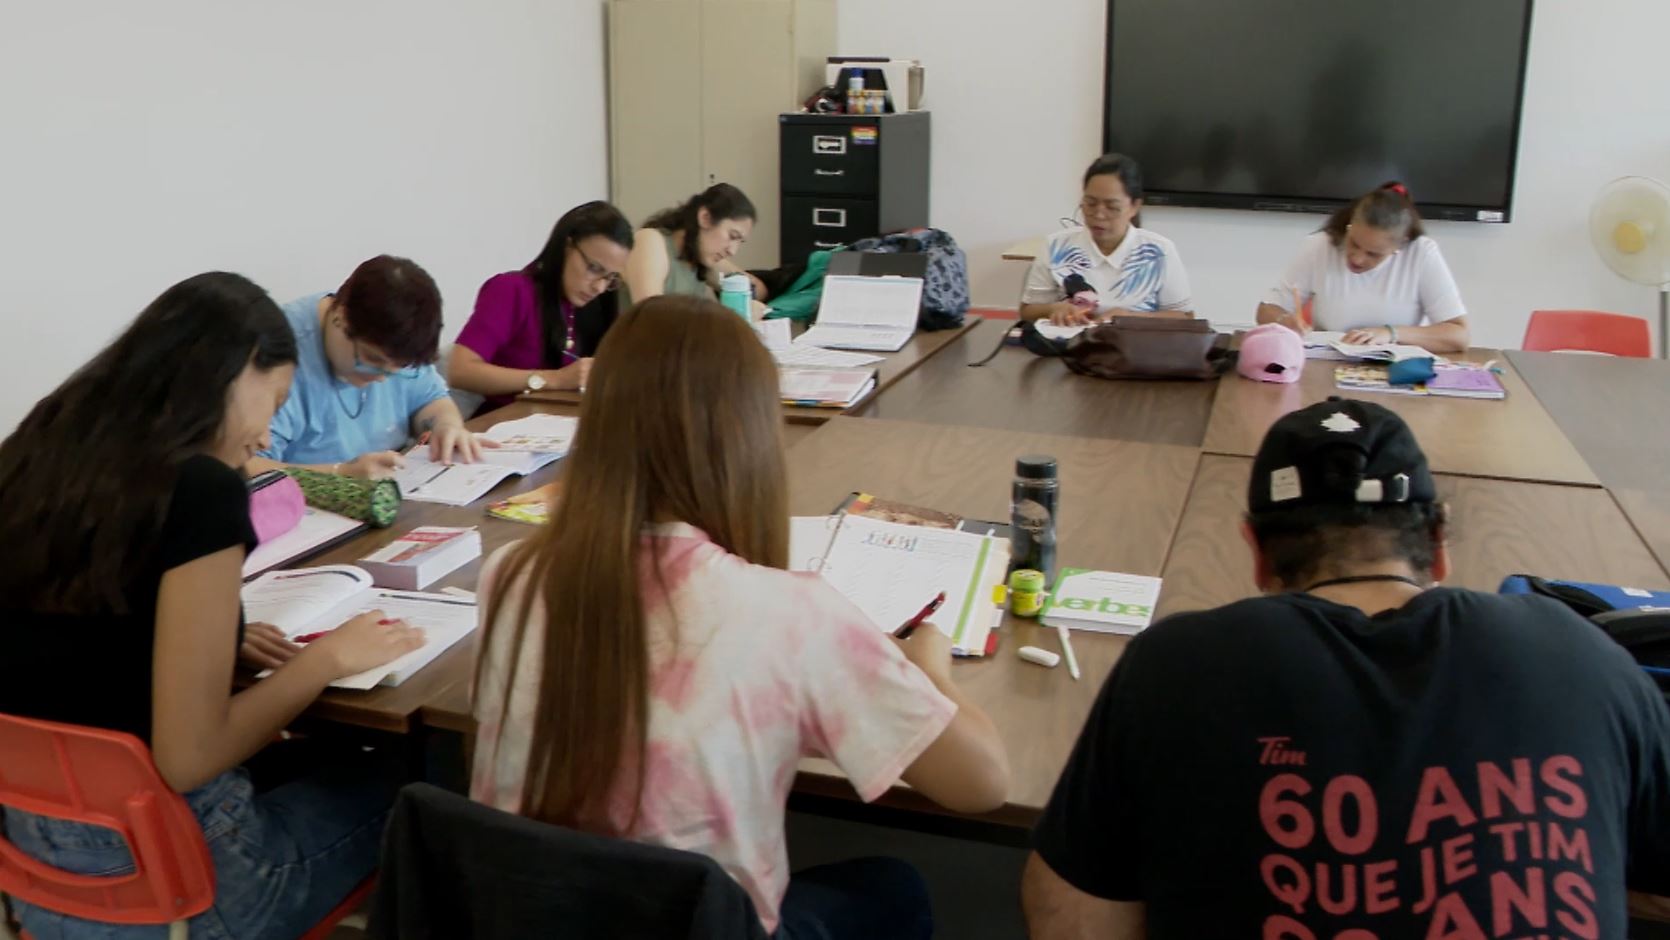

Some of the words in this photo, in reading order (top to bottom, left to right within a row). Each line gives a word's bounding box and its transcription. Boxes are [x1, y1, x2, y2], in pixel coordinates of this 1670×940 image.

[1257, 736, 1308, 767] Tim
[1259, 773, 1379, 856] 60
[1405, 754, 1589, 845] ANS
[1259, 853, 1401, 915] QUE
[1412, 833, 1478, 914] JE
[1489, 821, 1594, 874] TIM
[1423, 866, 1600, 940] ANS
